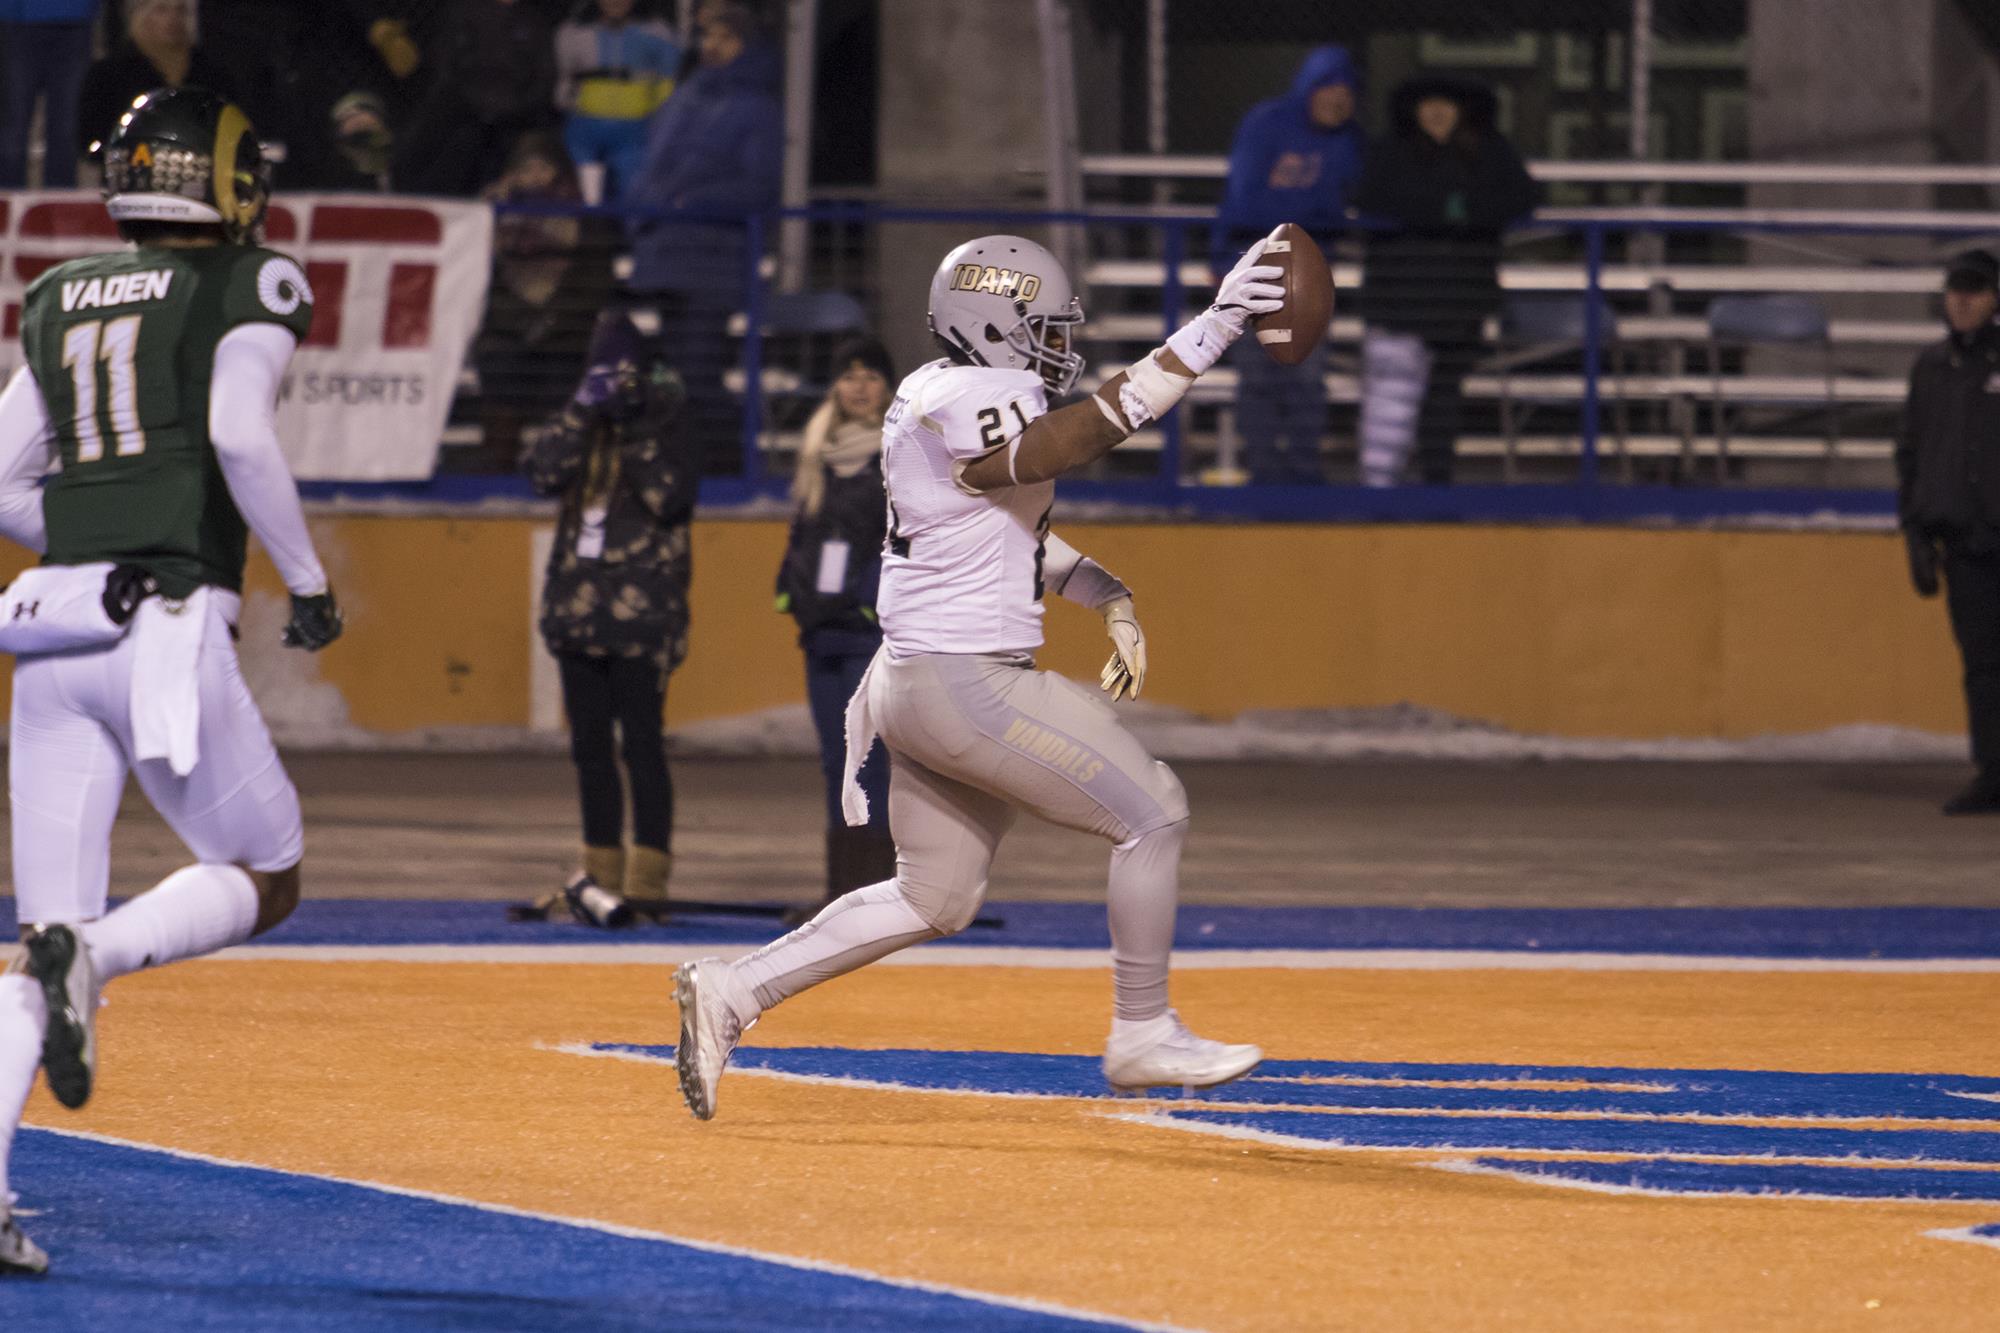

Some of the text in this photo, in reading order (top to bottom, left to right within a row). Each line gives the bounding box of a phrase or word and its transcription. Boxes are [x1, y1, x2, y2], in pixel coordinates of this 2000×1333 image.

[62, 269, 174, 313] VADEN
[950, 263, 1041, 303] IDAHO
[62, 314, 146, 463] 11
[303, 369, 424, 406] SPORTS
[977, 400, 1028, 450] 21
[1004, 718, 1105, 783] VANDALS
